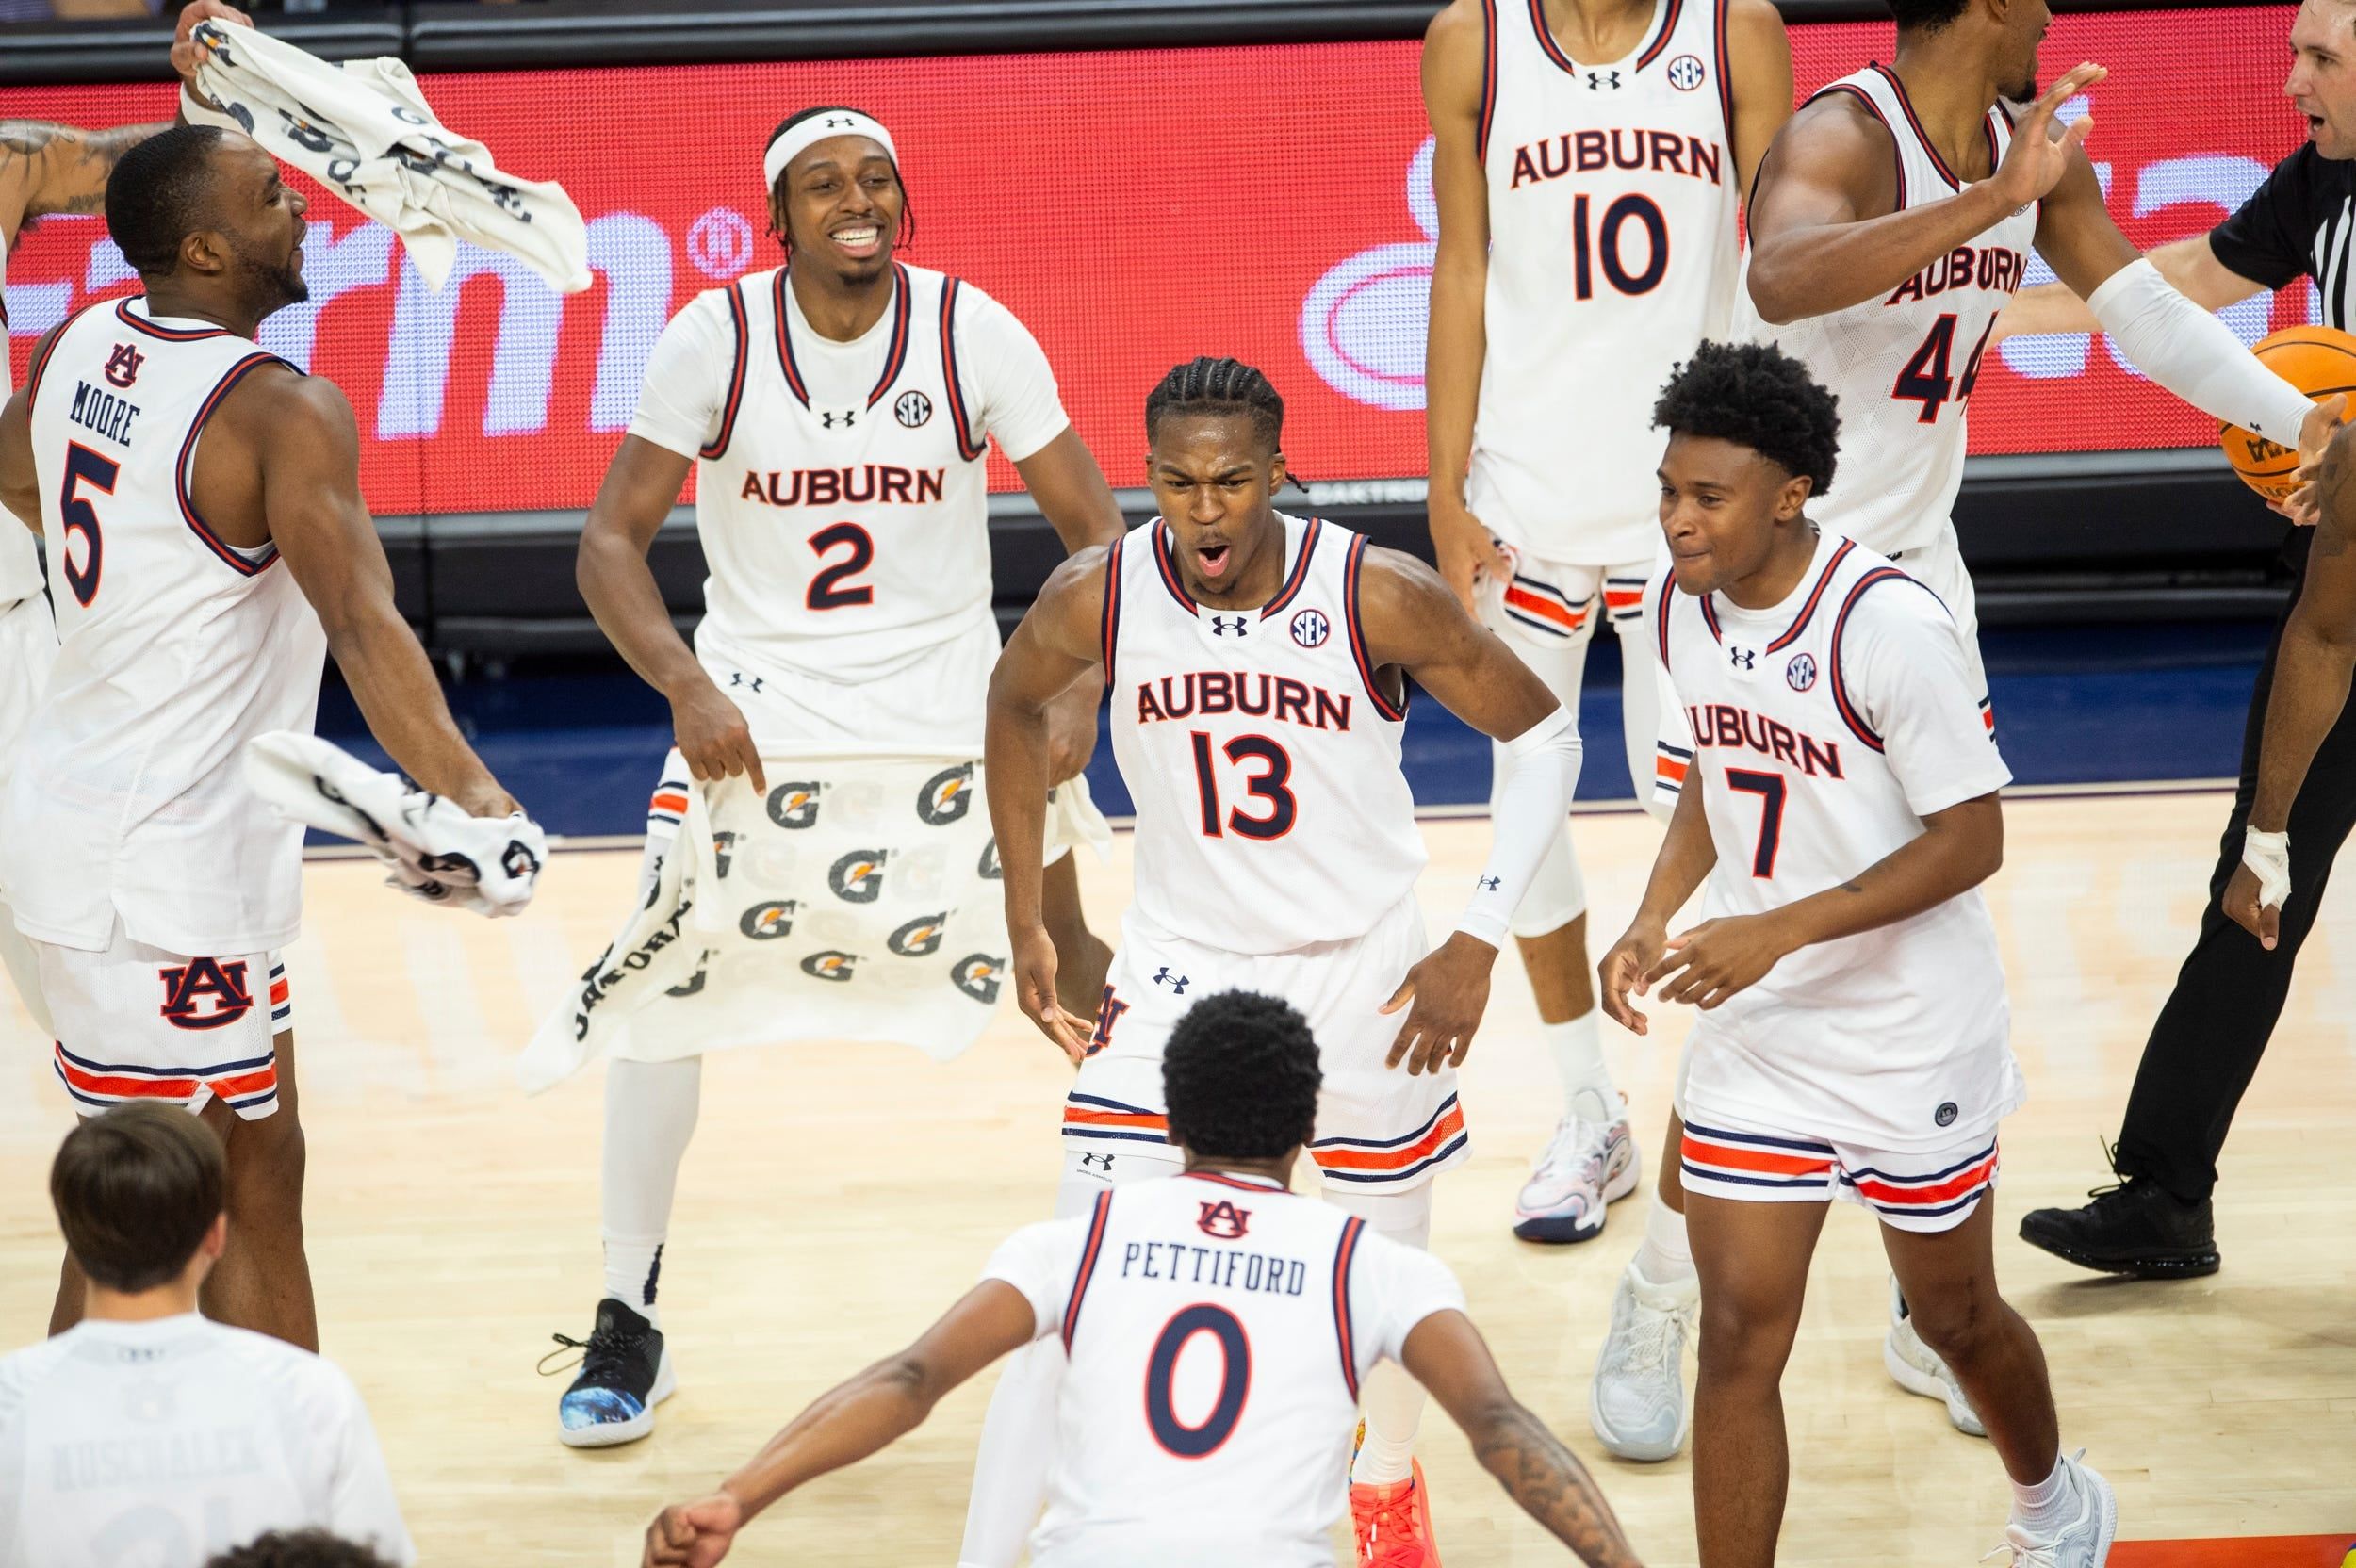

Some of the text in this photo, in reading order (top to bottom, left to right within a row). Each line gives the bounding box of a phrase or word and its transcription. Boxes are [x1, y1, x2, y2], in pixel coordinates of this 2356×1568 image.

[1669, 57, 1702, 90] SEC
[1510, 128, 1721, 189] AUBURN
[1573, 192, 1670, 301] 10
[69, 379, 140, 448] MOORE
[895, 391, 932, 427] SEC
[741, 464, 945, 507] AUBURN
[60, 437, 121, 608] 5
[806, 521, 875, 611] 2
[1292, 612, 1328, 646] SEC
[1137, 671, 1352, 732] AUBURN
[1787, 654, 1817, 690] SEC
[1684, 703, 1846, 780] UBURN
[1190, 730, 1298, 841] 13
[1725, 767, 1788, 879] 7
[1121, 1240, 1307, 1297] PETTIFORD
[1143, 1301, 1252, 1461] 0
